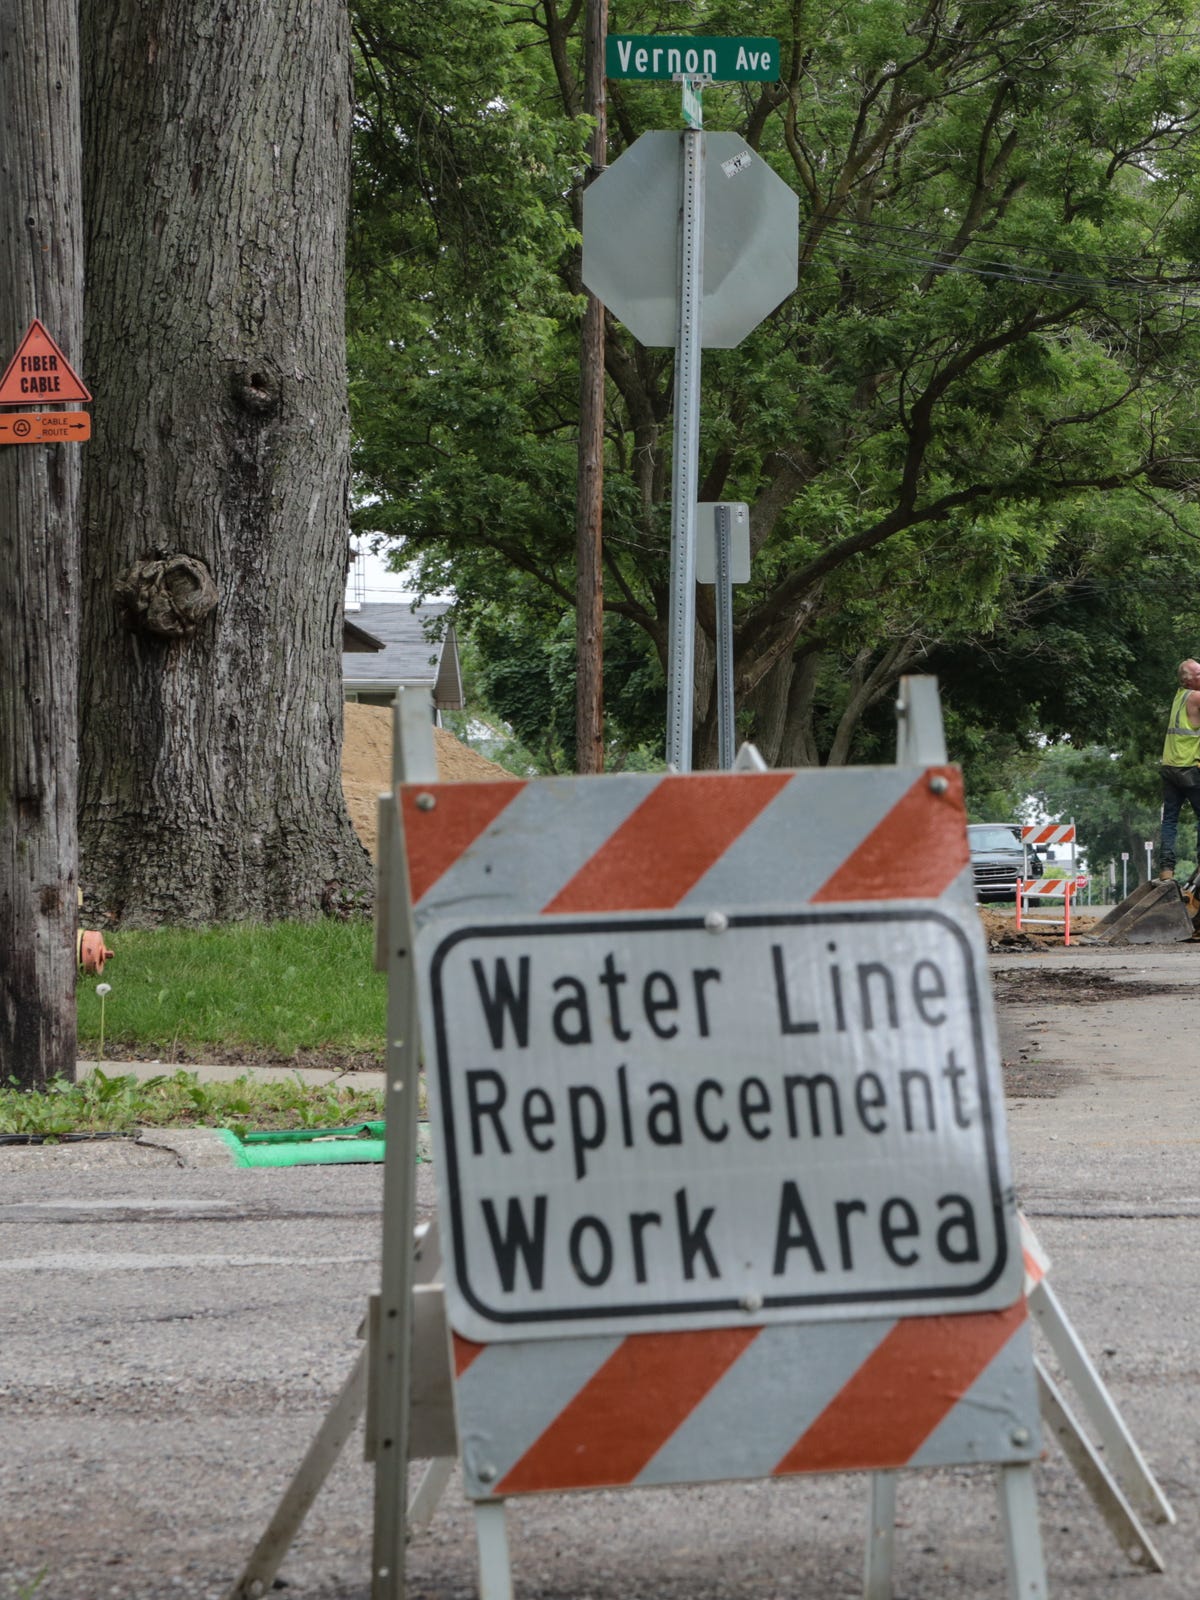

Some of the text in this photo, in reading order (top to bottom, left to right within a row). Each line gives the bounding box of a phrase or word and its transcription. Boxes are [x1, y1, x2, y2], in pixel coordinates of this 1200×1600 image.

[617, 40, 771, 73] Vernon Ave
[21, 355, 57, 372] FIBER
[20, 376, 60, 393] CABLE
[42, 418, 68, 426] CABLE
[471, 942, 947, 1050] Water Line
[465, 1050, 972, 1181] Replacement
[481, 1180, 981, 1293] Work Area
